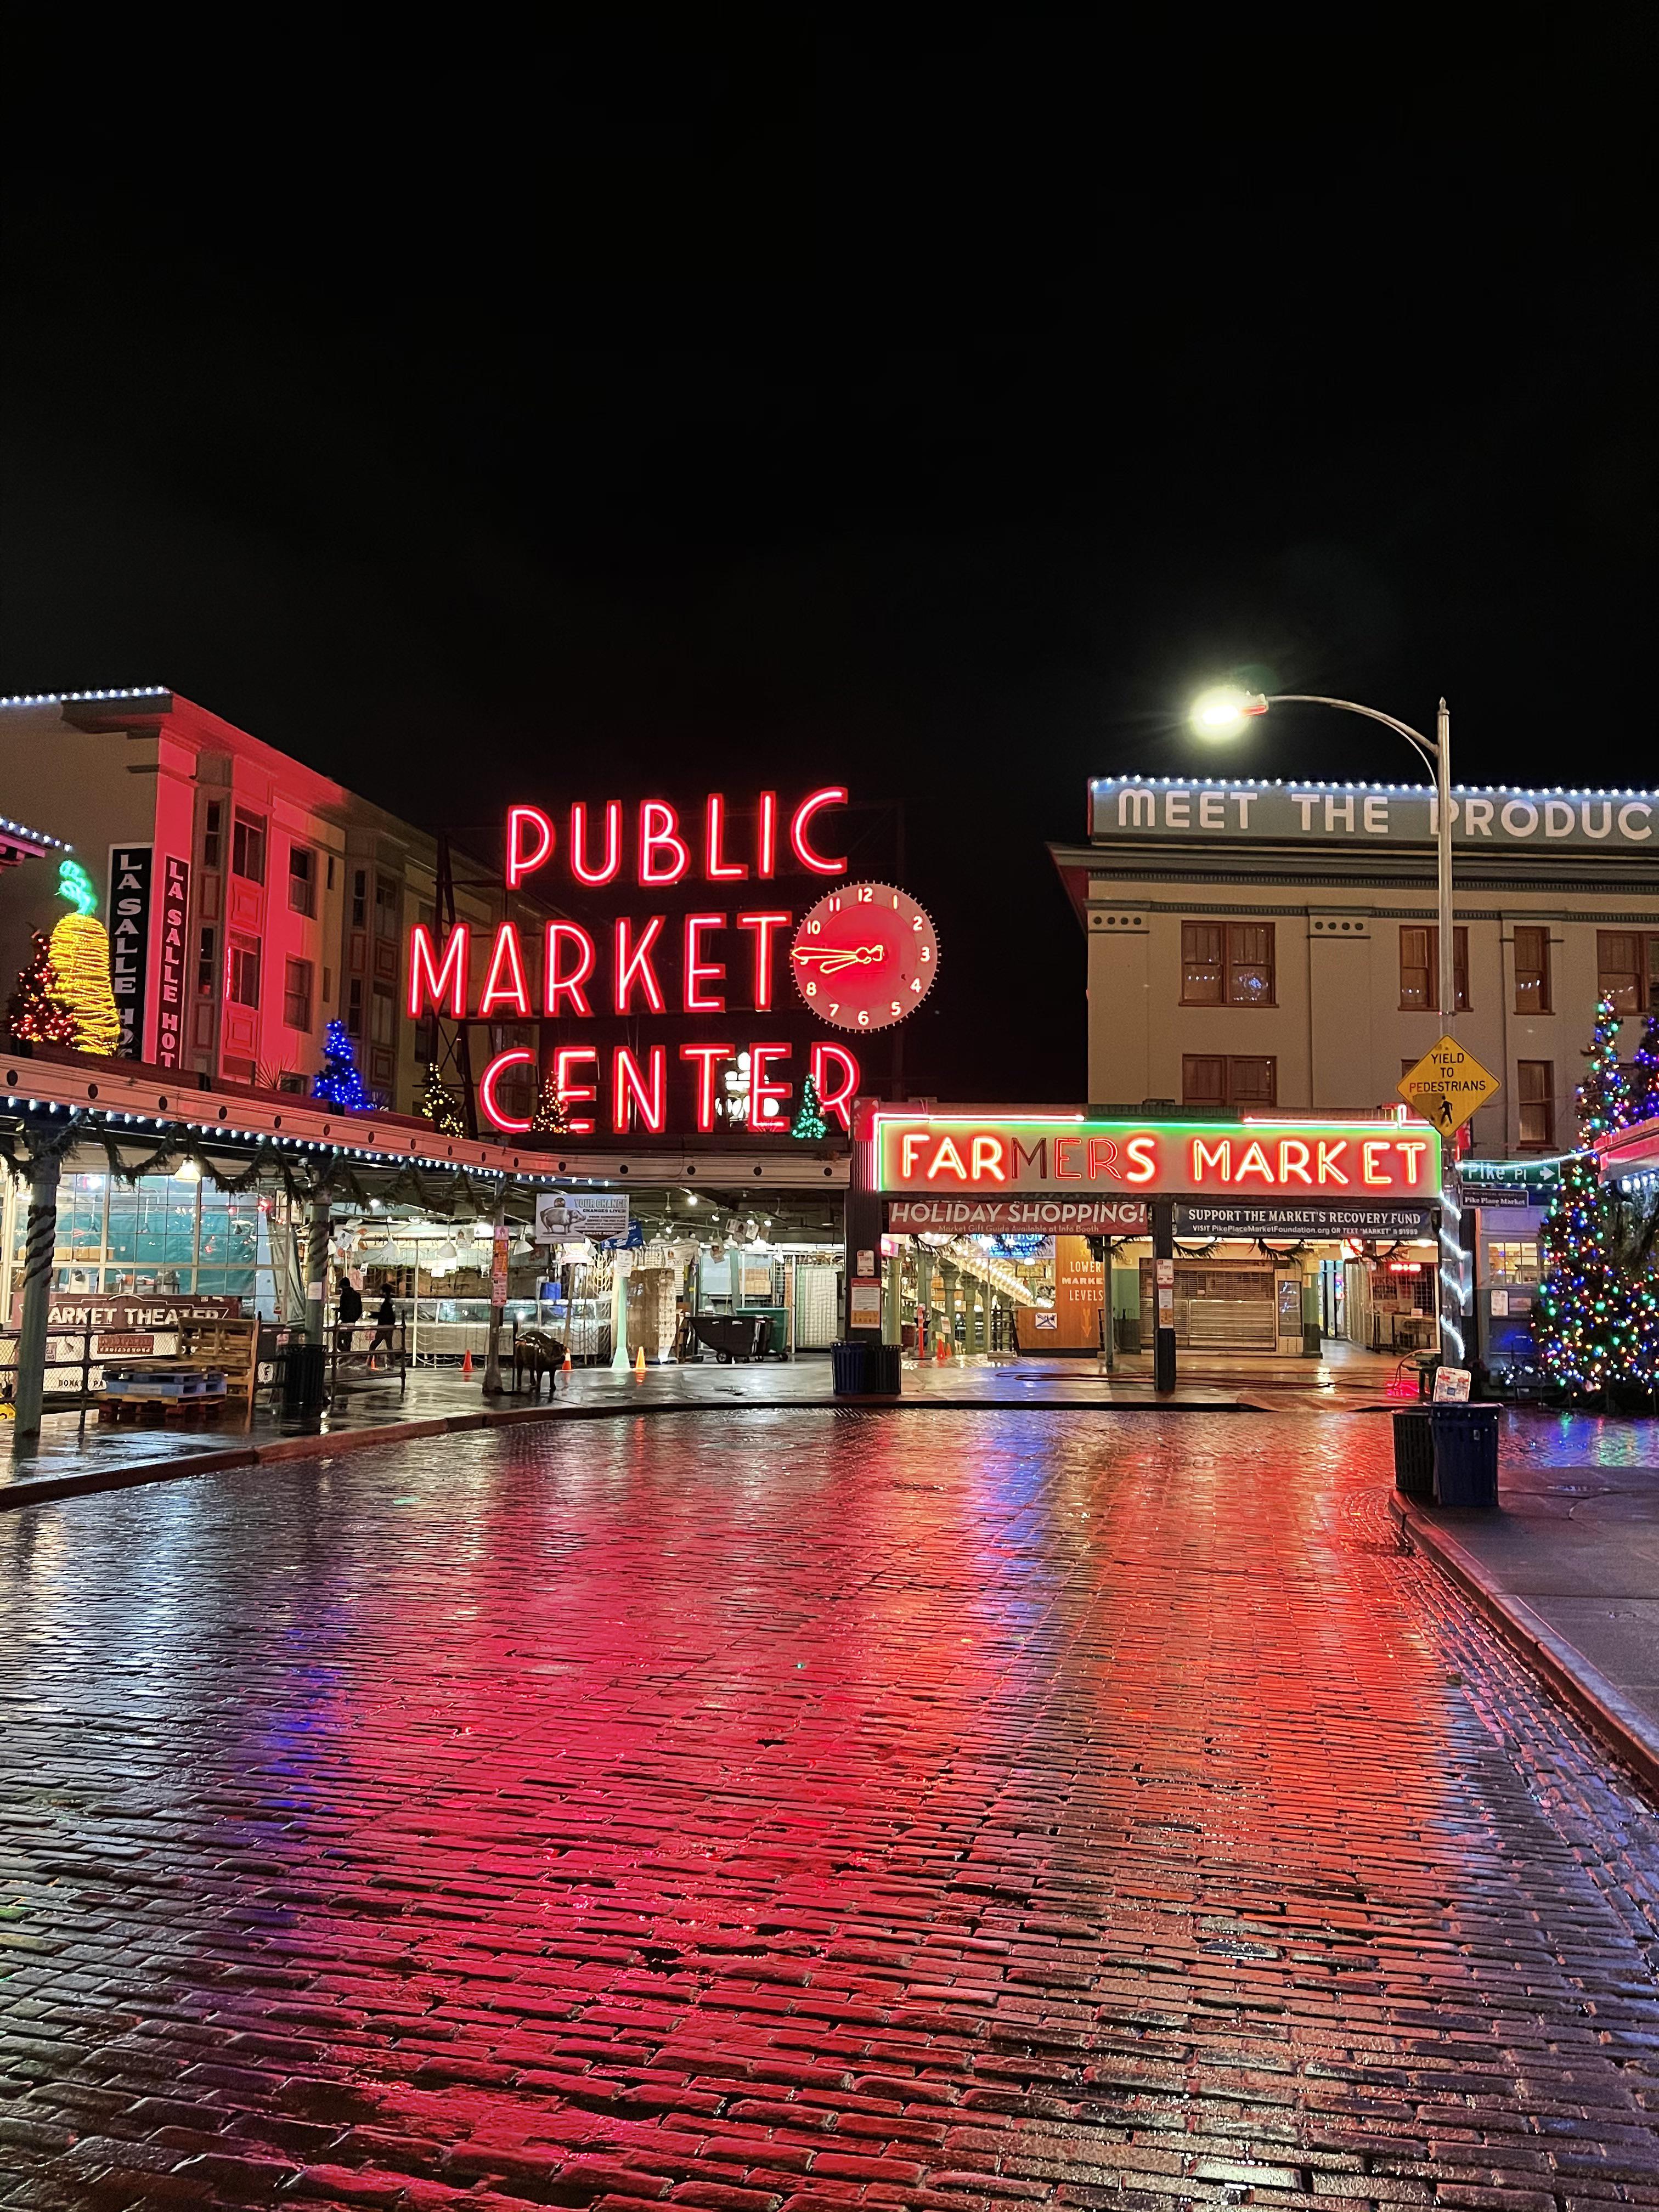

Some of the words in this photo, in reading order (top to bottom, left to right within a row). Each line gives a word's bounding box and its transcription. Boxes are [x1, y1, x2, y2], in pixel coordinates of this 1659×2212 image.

[1118, 788, 1257, 830] MEET
[1291, 793, 1389, 833] THE
[507, 787, 848, 890] PUBLIC
[116, 854, 142, 889] LA
[168, 861, 184, 900] LA
[857, 887, 873, 902] 12
[893, 894, 899, 910] 1
[828, 896, 840, 912] 11
[806, 920, 821, 935] 10
[913, 915, 923, 931] 2
[114, 898, 142, 994] SALLE
[920, 946, 930, 962] 3
[163, 909, 182, 1003] SALLE
[407, 911, 792, 1019] MARKET
[805, 981, 817, 996] 8
[910, 978, 922, 993] 4
[828, 1003, 839, 1017] 7
[890, 1001, 901, 1015] 5
[857, 1011, 869, 1026] 6
[1431, 1053, 1464, 1064] YIELD
[1440, 1067, 1454, 1078] TO
[481, 1042, 860, 1134] CENTER
[1409, 1080, 1486, 1093] PEDESTRIANS
[901, 1134, 1156, 1183] FARMERS
[1193, 1139, 1426, 1184] MARKET
[1468, 1163, 1505, 1180] Pike
[574, 1199, 596, 1209] YOUR
[891, 1203, 1003, 1223] HOLIDAY
[1007, 1202, 1146, 1223] SHOPPING!
[1188, 1209, 1241, 1221] SUPPORT
[1243, 1210, 1266, 1221] THE
[1268, 1211, 1326, 1222] MARKET'S
[1329, 1212, 1388, 1224] RECOVERY
[1391, 1213, 1421, 1224] FUND
[1070, 1261, 1102, 1272] LOWER
[1069, 1290, 1103, 1301] LEVELS
[48, 1307, 117, 1325] ARKET
